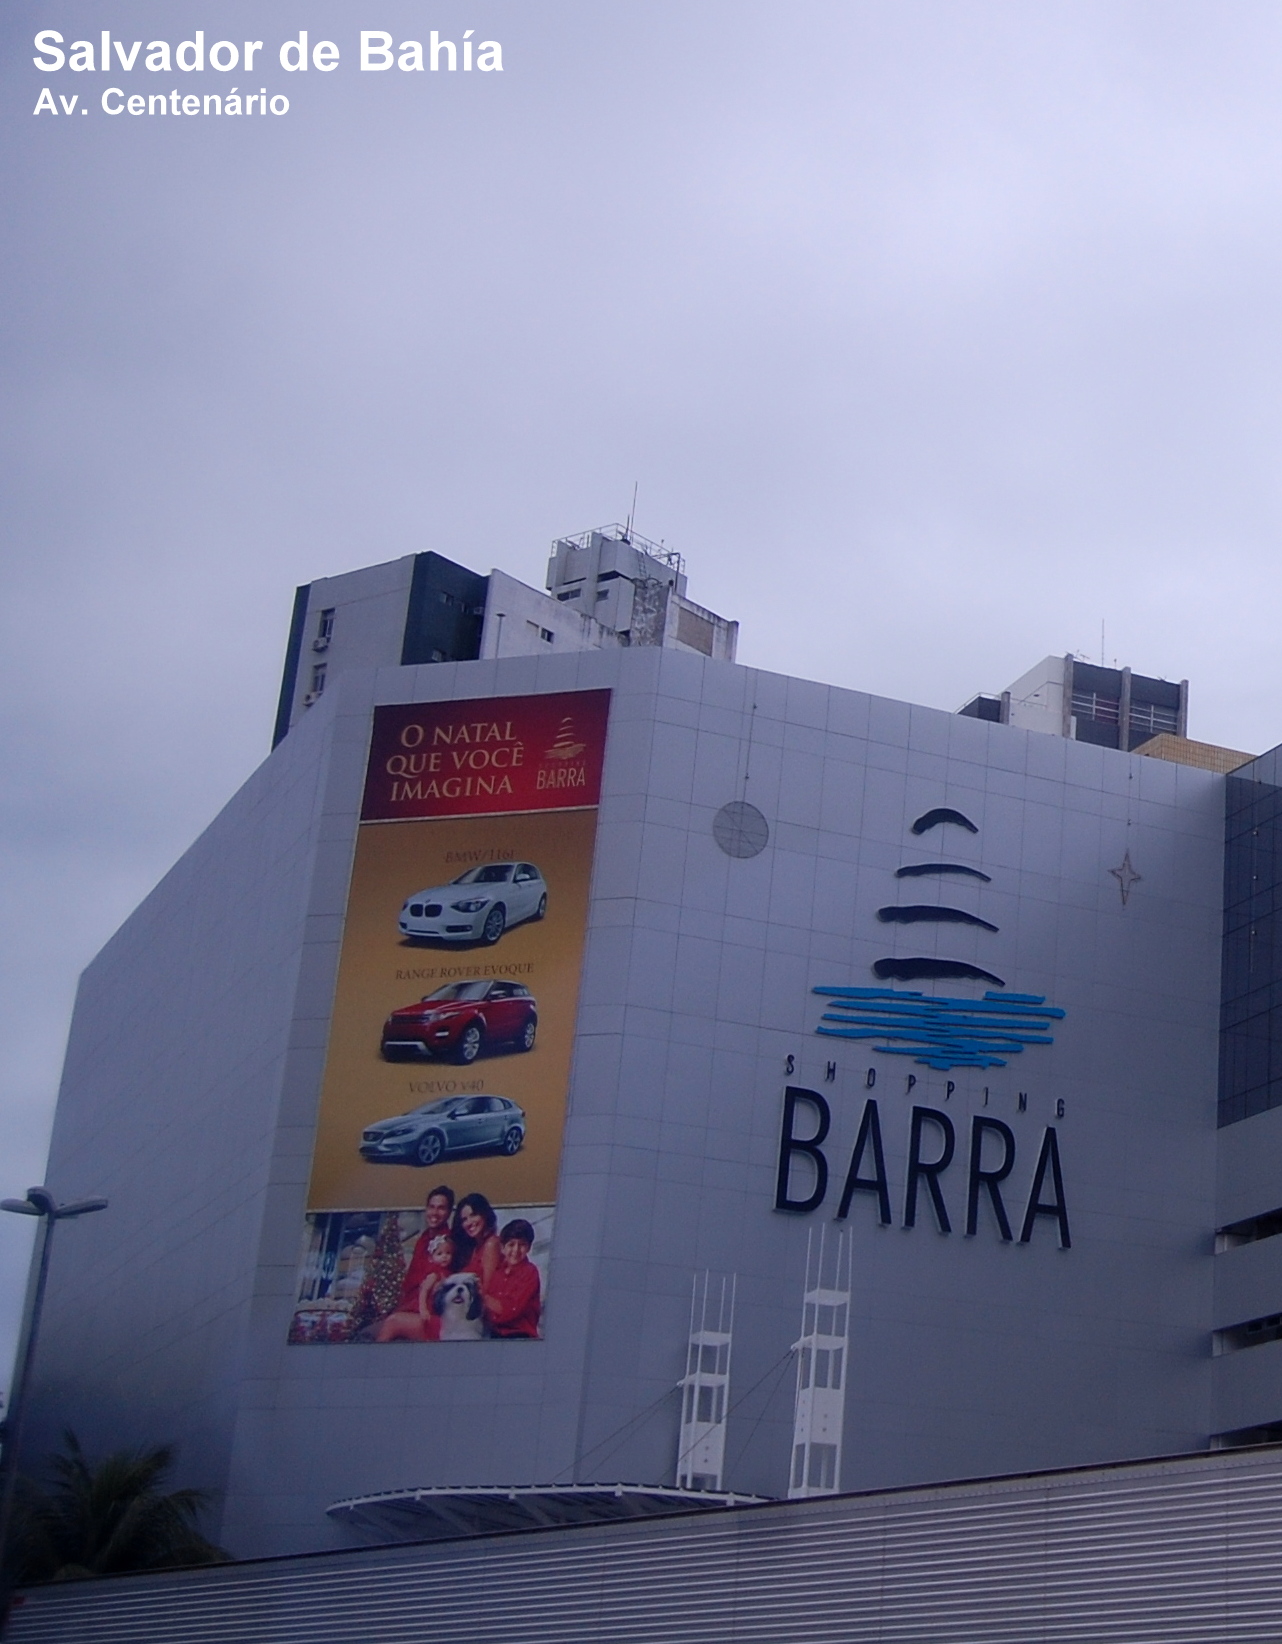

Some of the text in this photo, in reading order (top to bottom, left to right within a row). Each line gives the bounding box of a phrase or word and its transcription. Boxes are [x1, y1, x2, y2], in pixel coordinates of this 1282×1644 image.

[401, 721, 517, 748] O NATAL
[386, 742, 525, 779] QUE VOCÊ
[390, 775, 514, 802] IMAGINA
[536, 767, 586, 790] BARRA
[396, 962, 534, 980] RANGE ROVER EVOQUE
[409, 1080, 457, 1093] VOLVO
[785, 1054, 1065, 1119] SHOPPING
[773, 1086, 1071, 1249] BARRA
